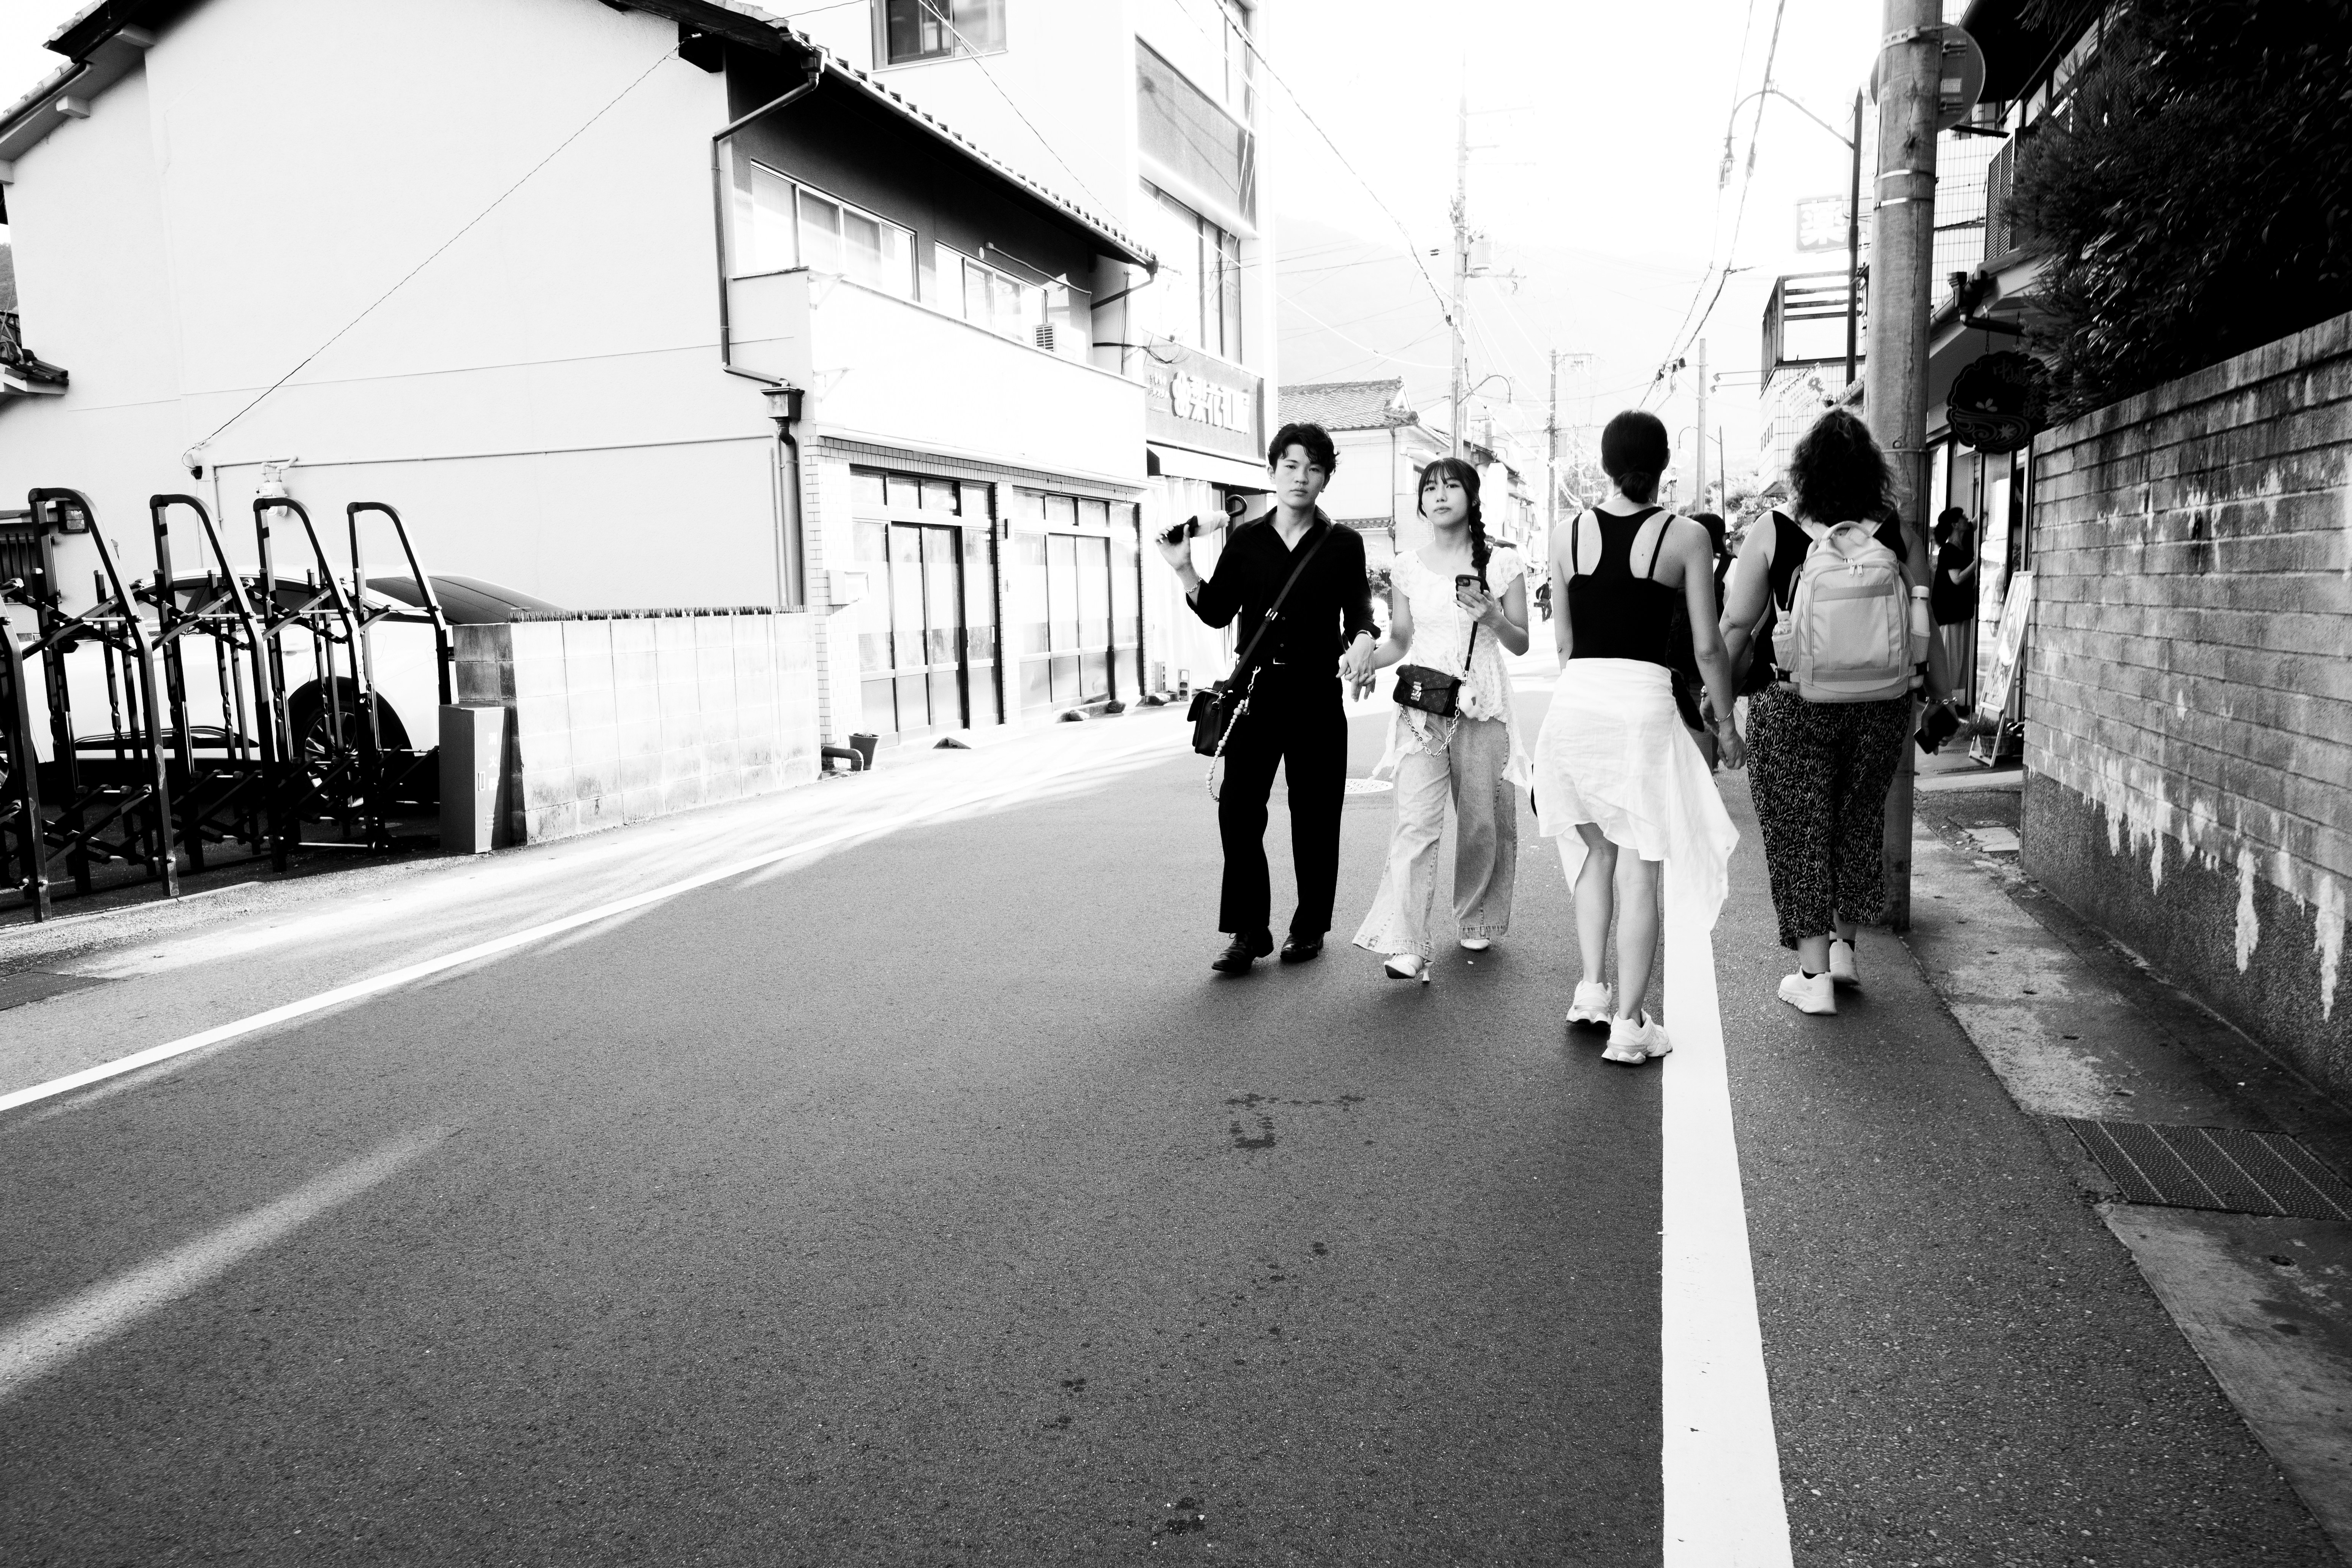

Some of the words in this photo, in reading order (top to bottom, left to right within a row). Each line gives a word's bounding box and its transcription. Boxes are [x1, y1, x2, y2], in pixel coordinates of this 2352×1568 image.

[1800, 198, 1847, 246] 薬
[1190, 375, 1250, 434] 梨花和服
[488, 731, 498, 791] 消火器
